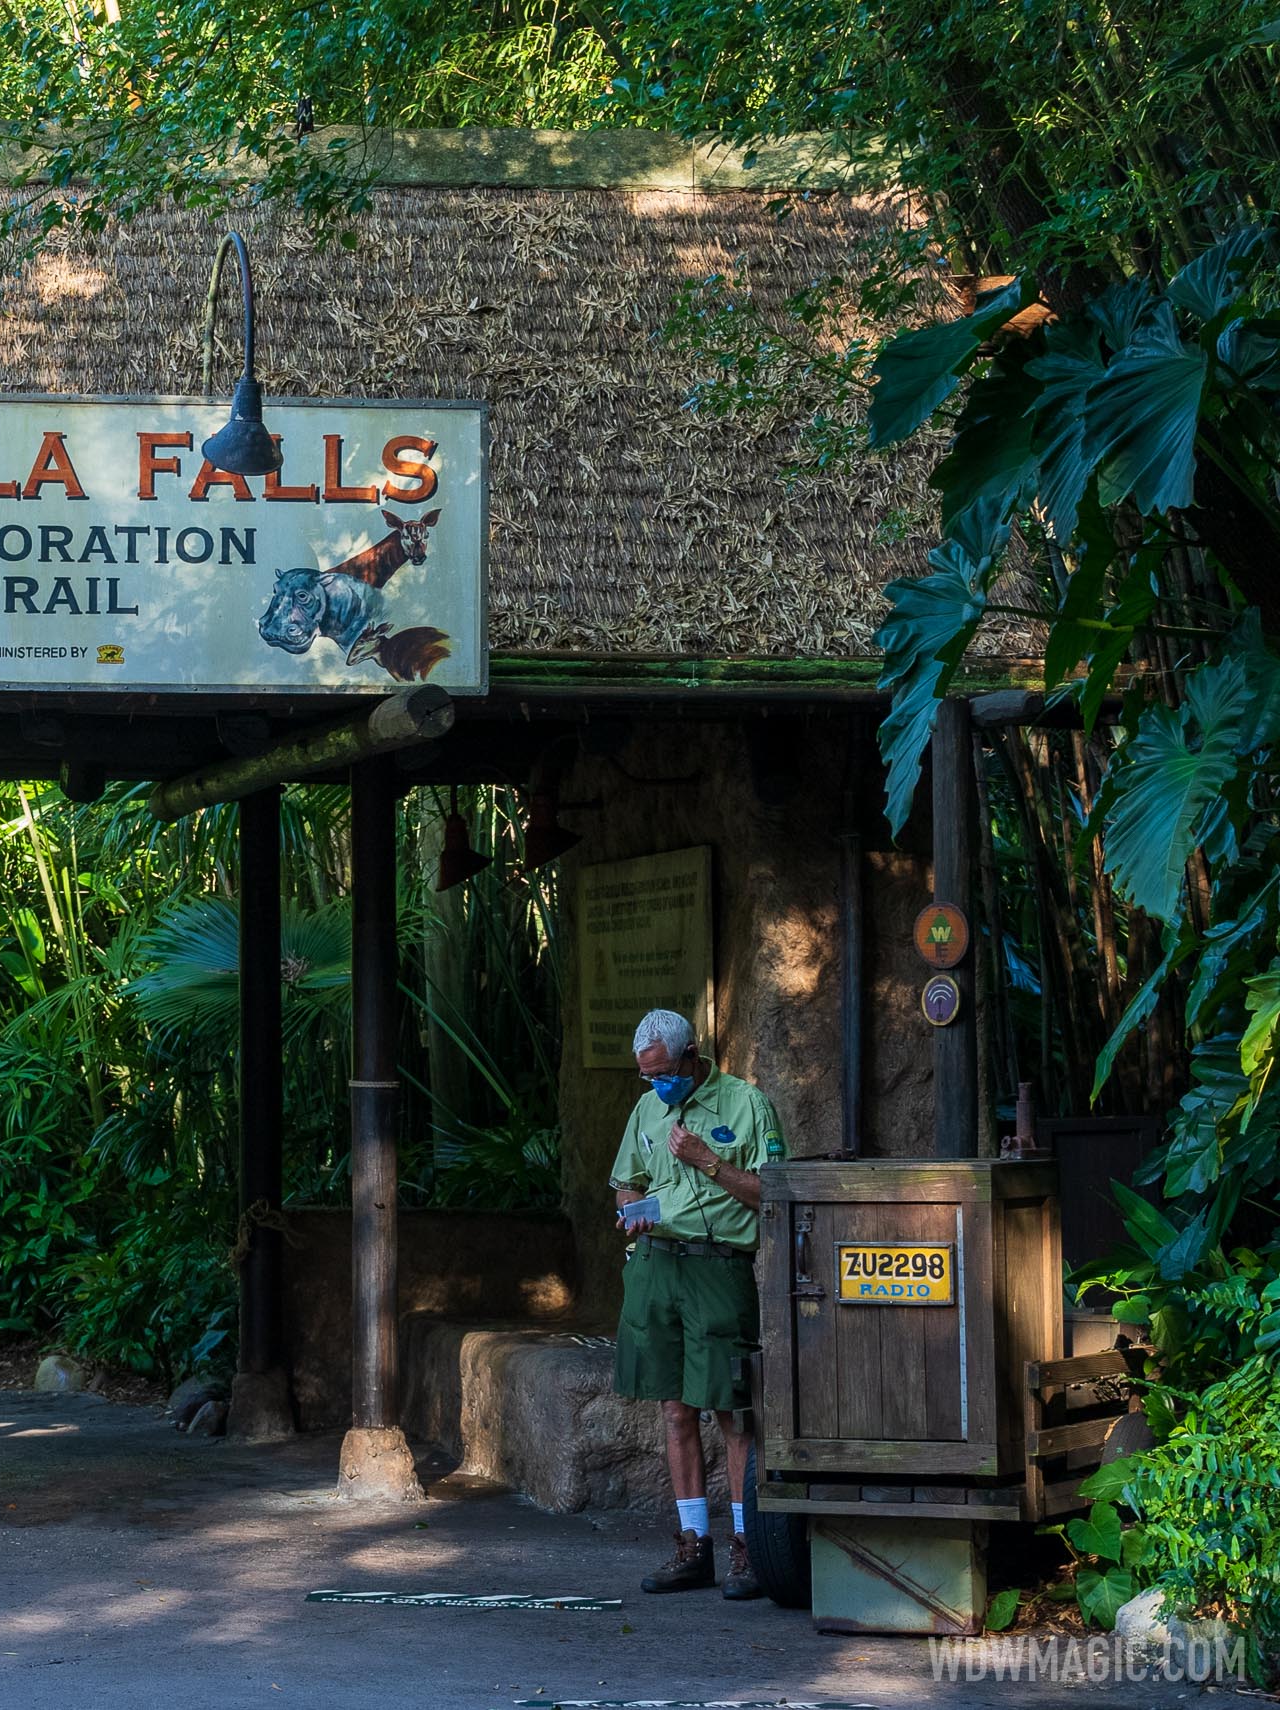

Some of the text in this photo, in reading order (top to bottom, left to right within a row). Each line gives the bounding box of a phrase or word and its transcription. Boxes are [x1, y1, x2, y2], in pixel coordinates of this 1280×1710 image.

[137, 430, 439, 505] FALLS
[71, 646, 88, 659] BY
[844, 1252, 945, 1282] ZU2298
[859, 1283, 931, 1297] RADIO
